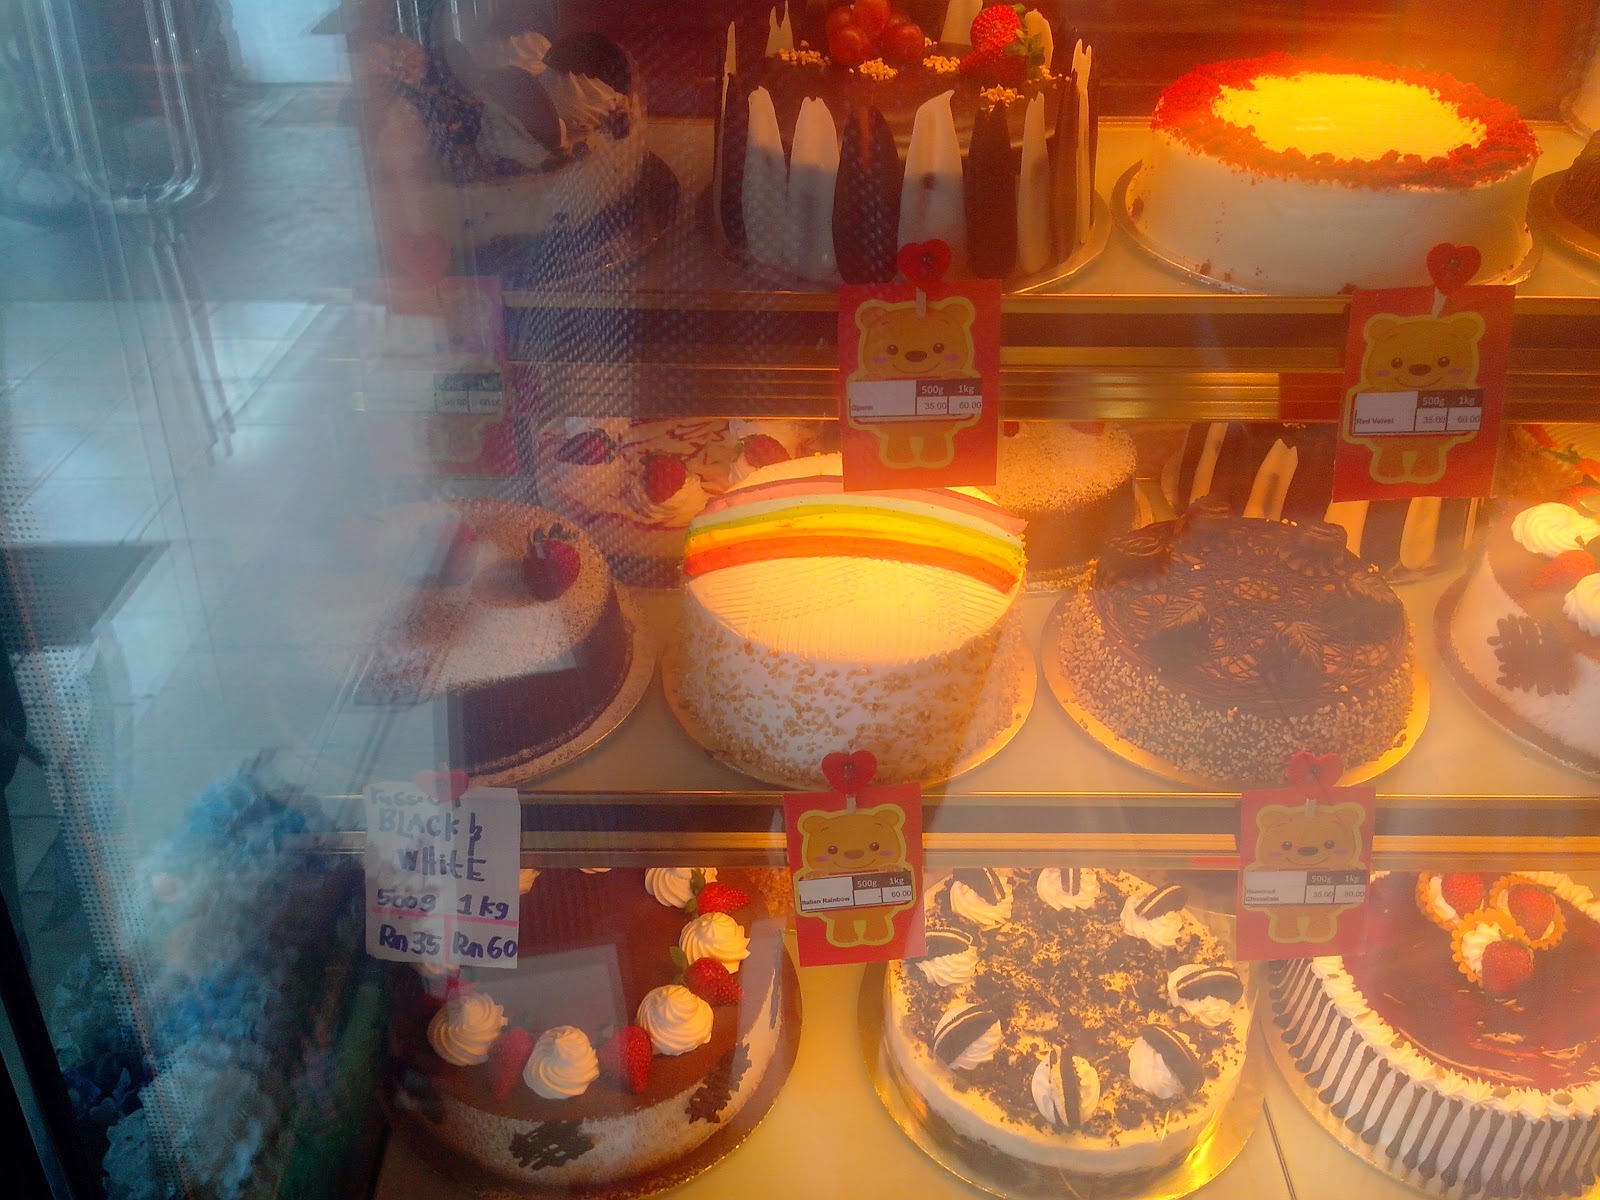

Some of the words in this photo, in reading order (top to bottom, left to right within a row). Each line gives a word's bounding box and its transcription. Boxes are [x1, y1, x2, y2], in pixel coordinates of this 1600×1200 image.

[921, 385, 944, 395] 500g
[958, 384, 975, 395] 1kg
[924, 402, 947, 410] 35.00
[959, 401, 982, 409] 60.00
[1422, 396, 1445, 407] 500g
[1459, 396, 1476, 406] 1kg
[1423, 416, 1446, 424] 35.00
[1457, 415, 1480, 424] 60.00
[857, 880, 878, 888] 500g
[889, 877, 905, 886] 1kg
[1345, 874, 1361, 883] 1kg
[377, 888, 437, 913] 500g
